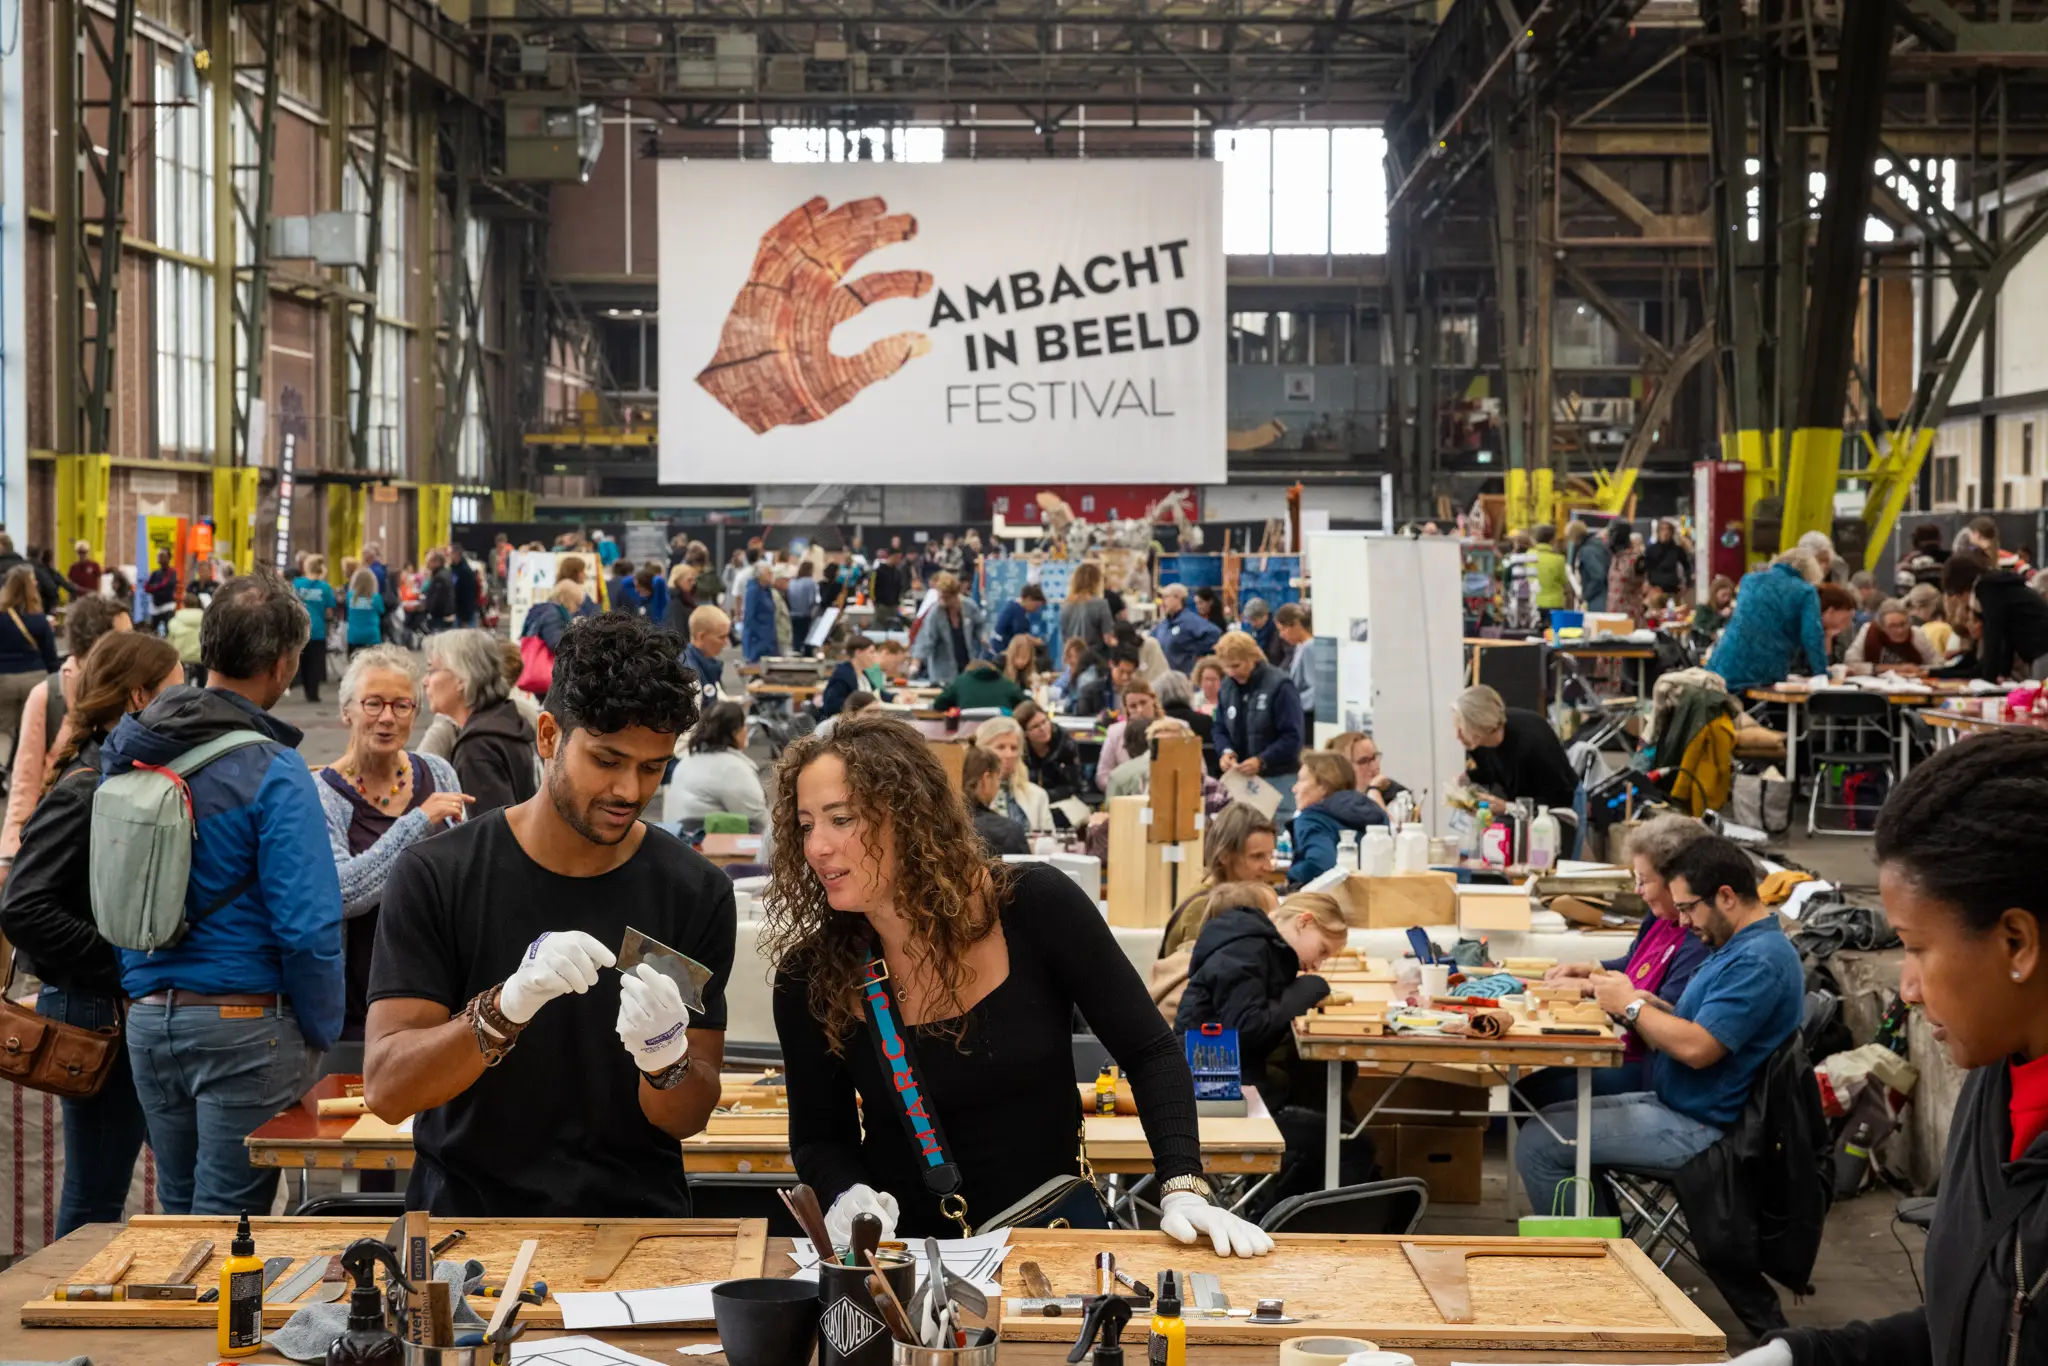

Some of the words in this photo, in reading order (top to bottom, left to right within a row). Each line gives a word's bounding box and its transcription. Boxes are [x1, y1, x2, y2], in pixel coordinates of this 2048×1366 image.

[928, 239, 1189, 328] AMBACHT
[965, 329, 1018, 372] IN
[1035, 306, 1200, 363] BEELD
[946, 378, 1175, 424] FESTIVAL
[882, 1034, 943, 1156] MARC
